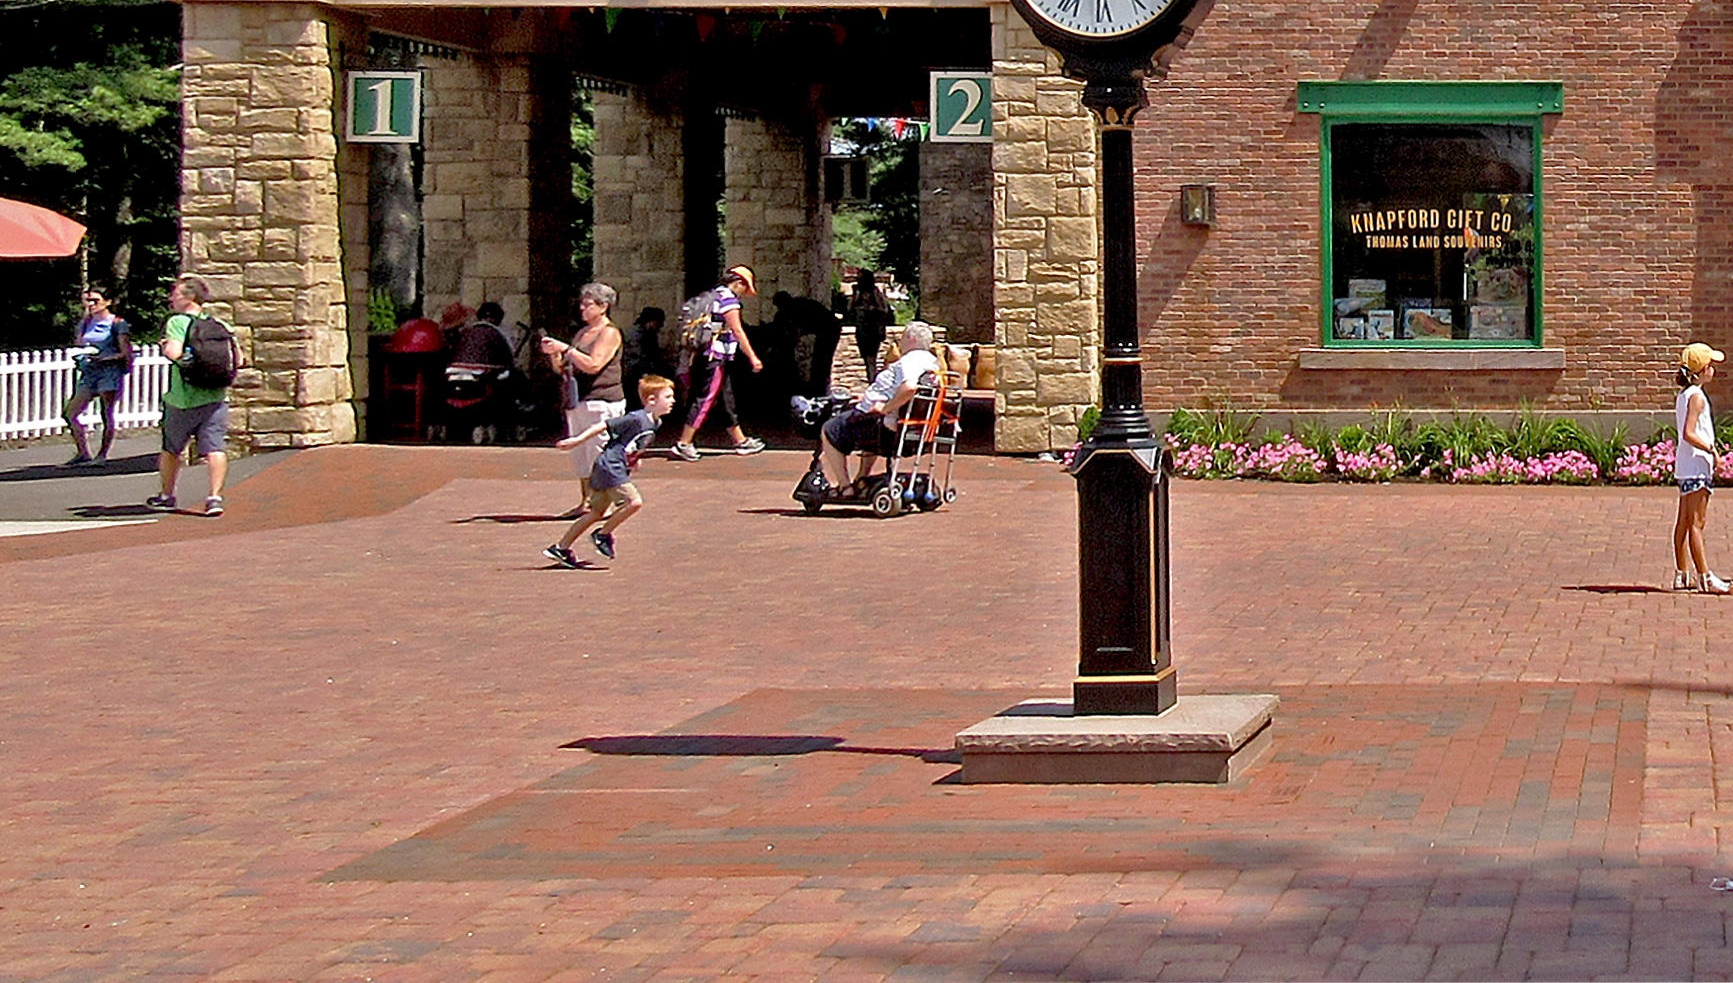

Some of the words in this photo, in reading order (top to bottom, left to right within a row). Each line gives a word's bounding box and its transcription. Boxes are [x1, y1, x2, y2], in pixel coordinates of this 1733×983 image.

[367, 79, 399, 135] 1
[947, 79, 984, 135] 2
[1350, 209, 1440, 234] KNAPFORD
[1447, 209, 1484, 230] GIFT
[1366, 235, 1409, 249] THOMAS
[1412, 235, 1440, 249] LAND
[1443, 235, 1502, 249] SOUVENIRS
